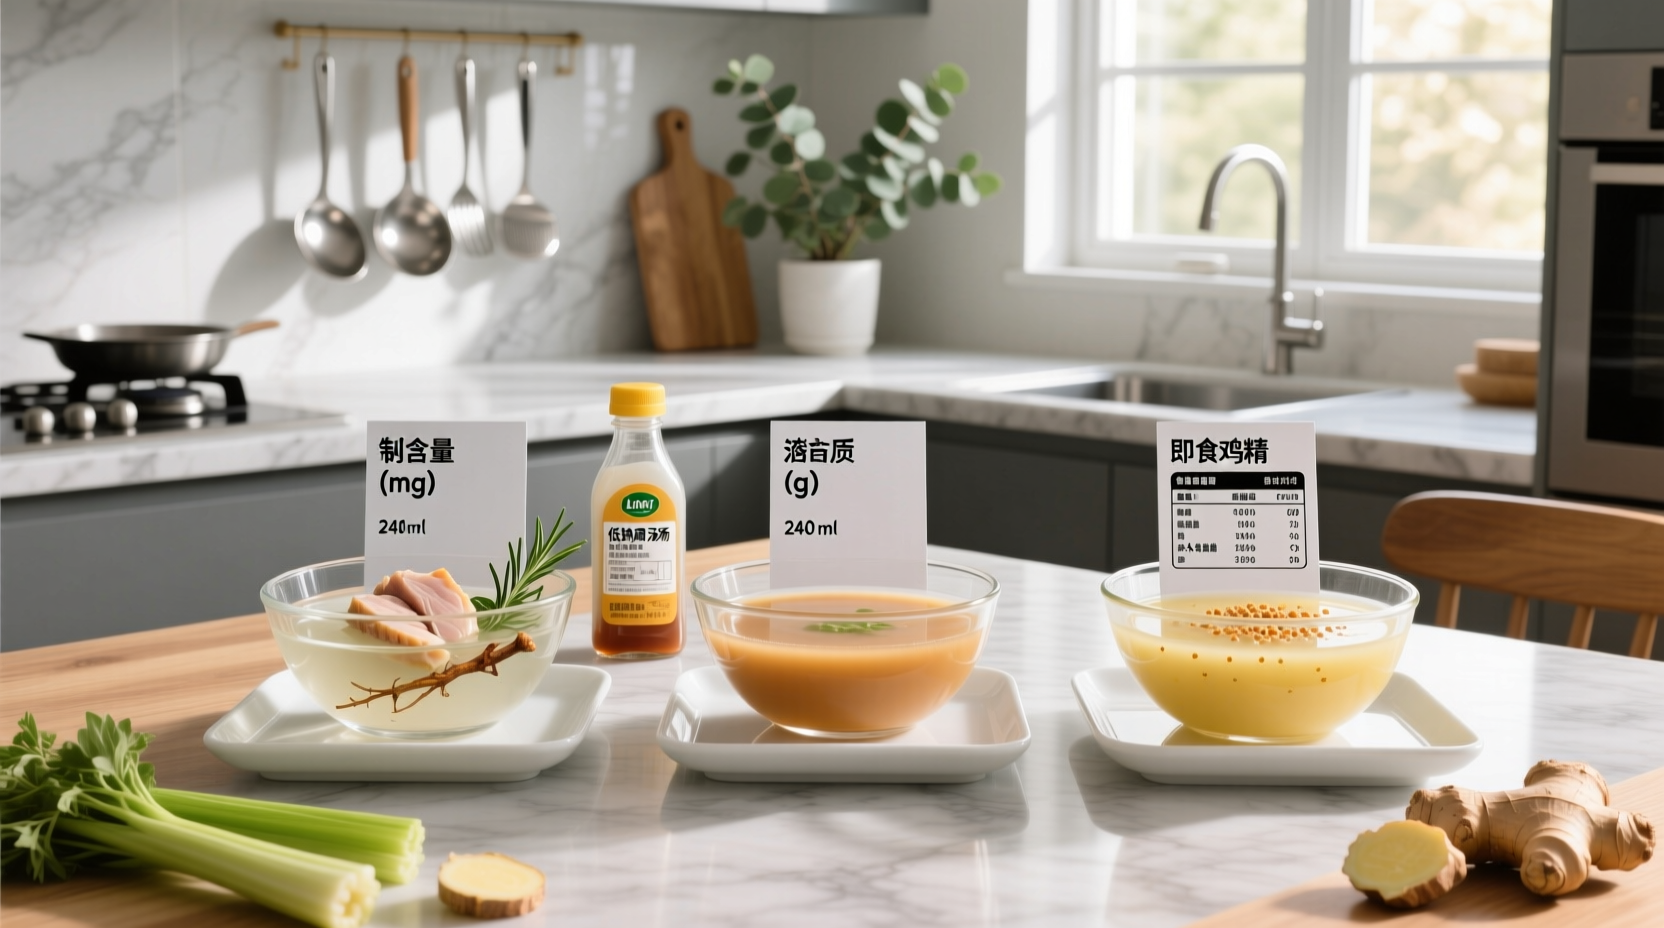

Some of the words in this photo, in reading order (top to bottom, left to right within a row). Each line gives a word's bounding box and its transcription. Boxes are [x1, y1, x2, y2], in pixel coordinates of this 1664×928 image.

[379, 436, 455, 464] 制含量
[1171, 437, 1269, 465] 即食鸡精
[380, 469, 436, 499] (mg)
[784, 469, 819, 499] (g)
